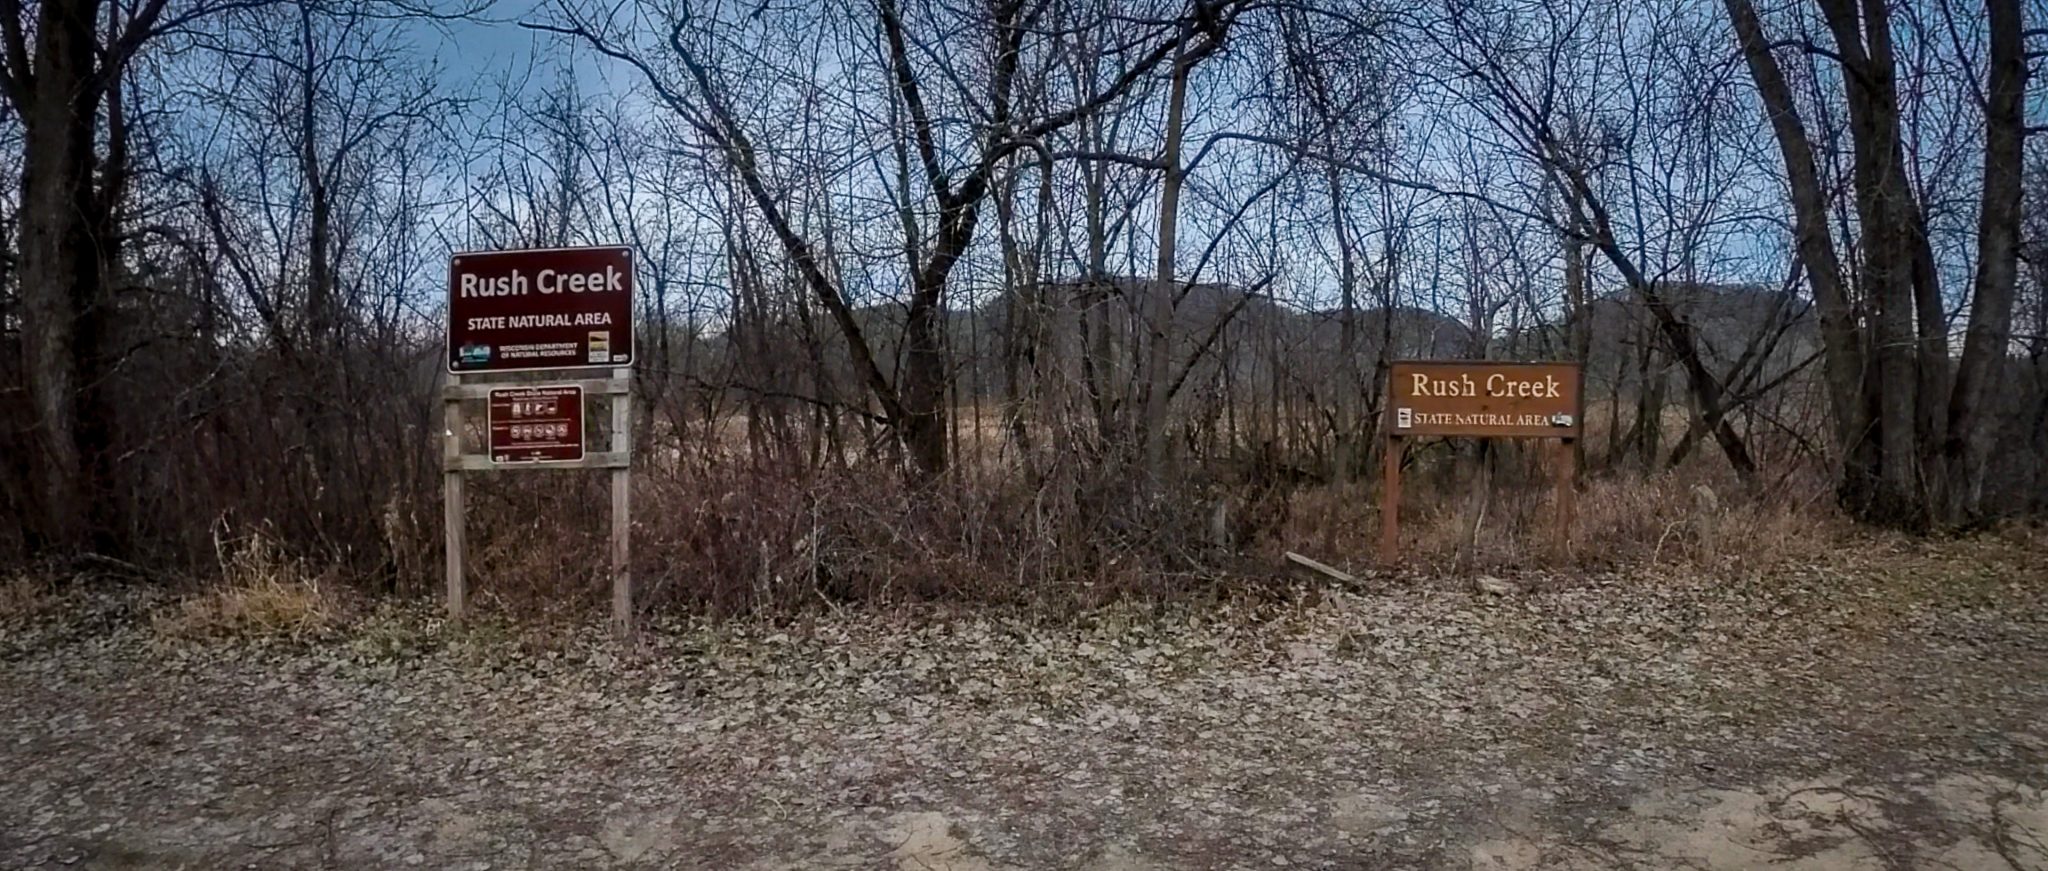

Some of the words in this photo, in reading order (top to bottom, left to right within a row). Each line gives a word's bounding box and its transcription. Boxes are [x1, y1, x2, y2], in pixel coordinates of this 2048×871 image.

[460, 268, 528, 298] Rush
[536, 265, 623, 294] Creek
[468, 316, 505, 331] STATE
[509, 313, 571, 328] NATURAL
[575, 311, 612, 325] AREA
[510, 350, 539, 359] NATURAL
[540, 347, 576, 357] RESOURCES
[536, 342, 578, 350] DEPARTMENT
[1411, 372, 1476, 397] Rush
[1486, 373, 1560, 398] Creek
[1414, 412, 1452, 425] STATE
[1455, 413, 1514, 426] NATURAL
[1516, 414, 1550, 427] AREA
